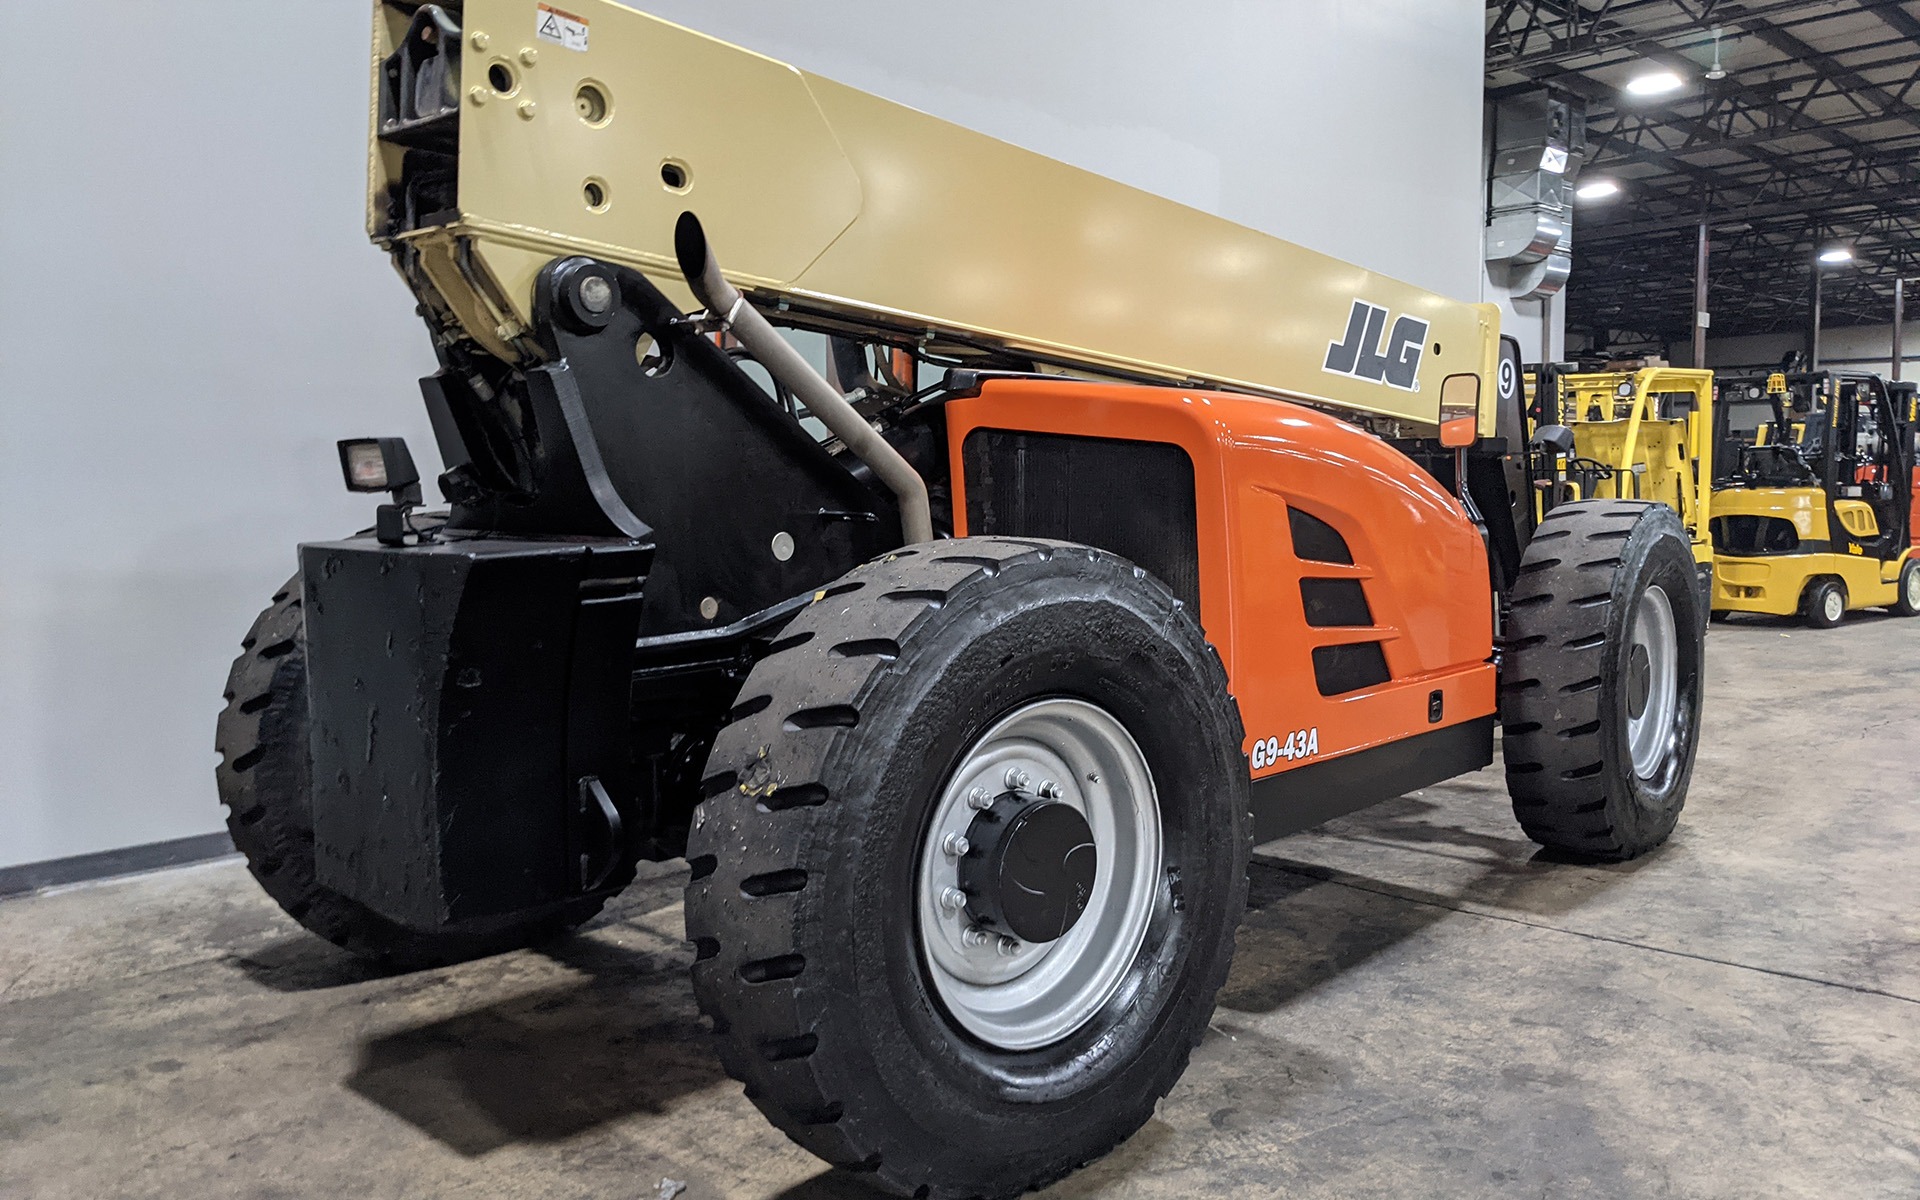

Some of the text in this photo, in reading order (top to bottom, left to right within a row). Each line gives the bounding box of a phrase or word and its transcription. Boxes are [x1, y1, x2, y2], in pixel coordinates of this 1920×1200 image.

[1322, 298, 1429, 391] JLG
[1501, 362, 1512, 395] 9
[1557, 374, 1565, 427] HYSTER
[1848, 542, 1863, 555] Yale
[1252, 727, 1318, 769] G9-43A
